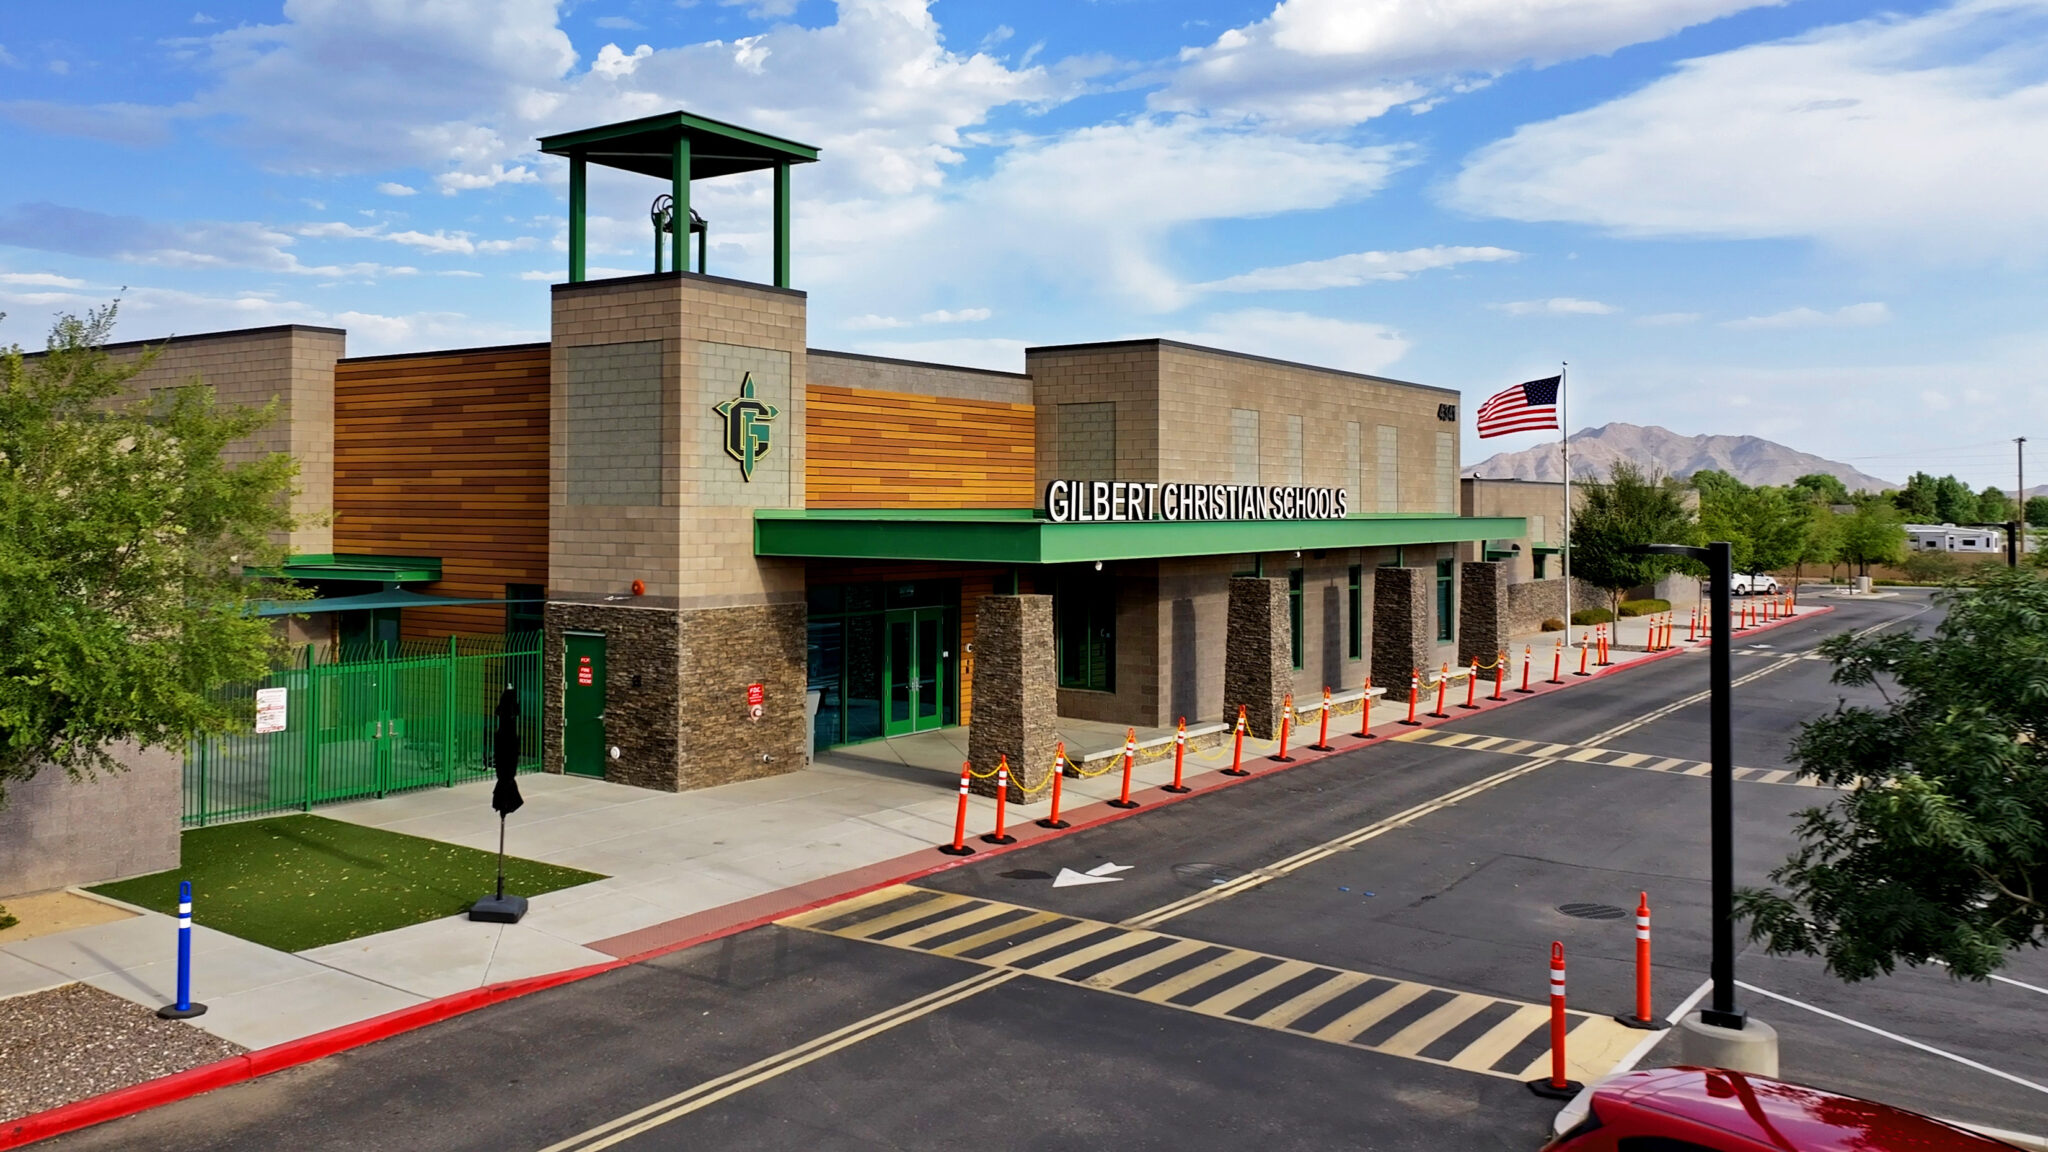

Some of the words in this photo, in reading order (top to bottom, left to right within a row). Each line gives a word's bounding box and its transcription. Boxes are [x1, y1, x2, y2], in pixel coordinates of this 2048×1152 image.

[1046, 480, 1158, 522] GILBERT
[1161, 483, 1267, 520] CHRISTIAN
[1269, 487, 1347, 519] SCHOOLS
